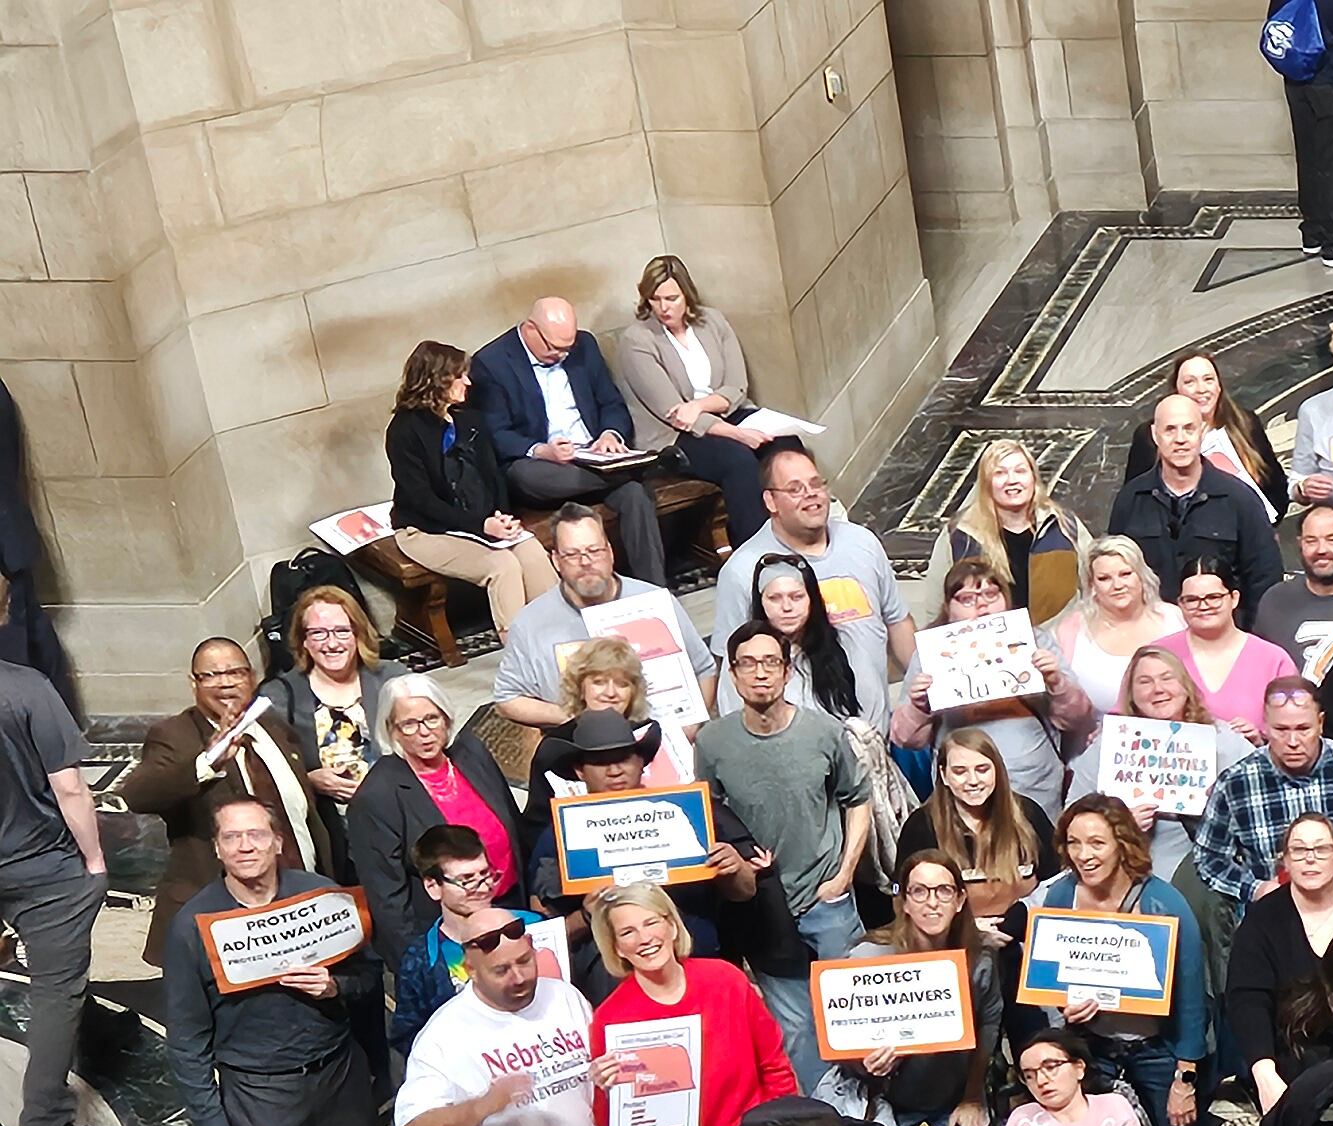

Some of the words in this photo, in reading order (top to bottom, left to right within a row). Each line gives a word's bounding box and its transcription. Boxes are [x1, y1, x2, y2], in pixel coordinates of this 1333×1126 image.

[1131, 739, 1160, 750] NOT
[1166, 741, 1192, 753] ALL
[1114, 752, 1208, 772] DISABILITIES
[1115, 770, 1143, 783] ARE
[1149, 773, 1206, 788] VISIBLE
[586, 815, 631, 828] Protect
[634, 810, 675, 823] AD/TBI
[604, 828, 660, 842] WAIVERS
[247, 903, 318, 931] PROTECT
[223, 934, 277, 952] AD/TBI
[280, 908, 351, 940] WAIVERS
[1056, 933, 1098, 944] Protect
[1101, 936, 1141, 948] AD/TBI
[1069, 950, 1121, 962] WAIVERS
[853, 970, 921, 986] PROTECT
[828, 993, 879, 1010] AD/TBI
[881, 989, 952, 1005] WAIVERS
